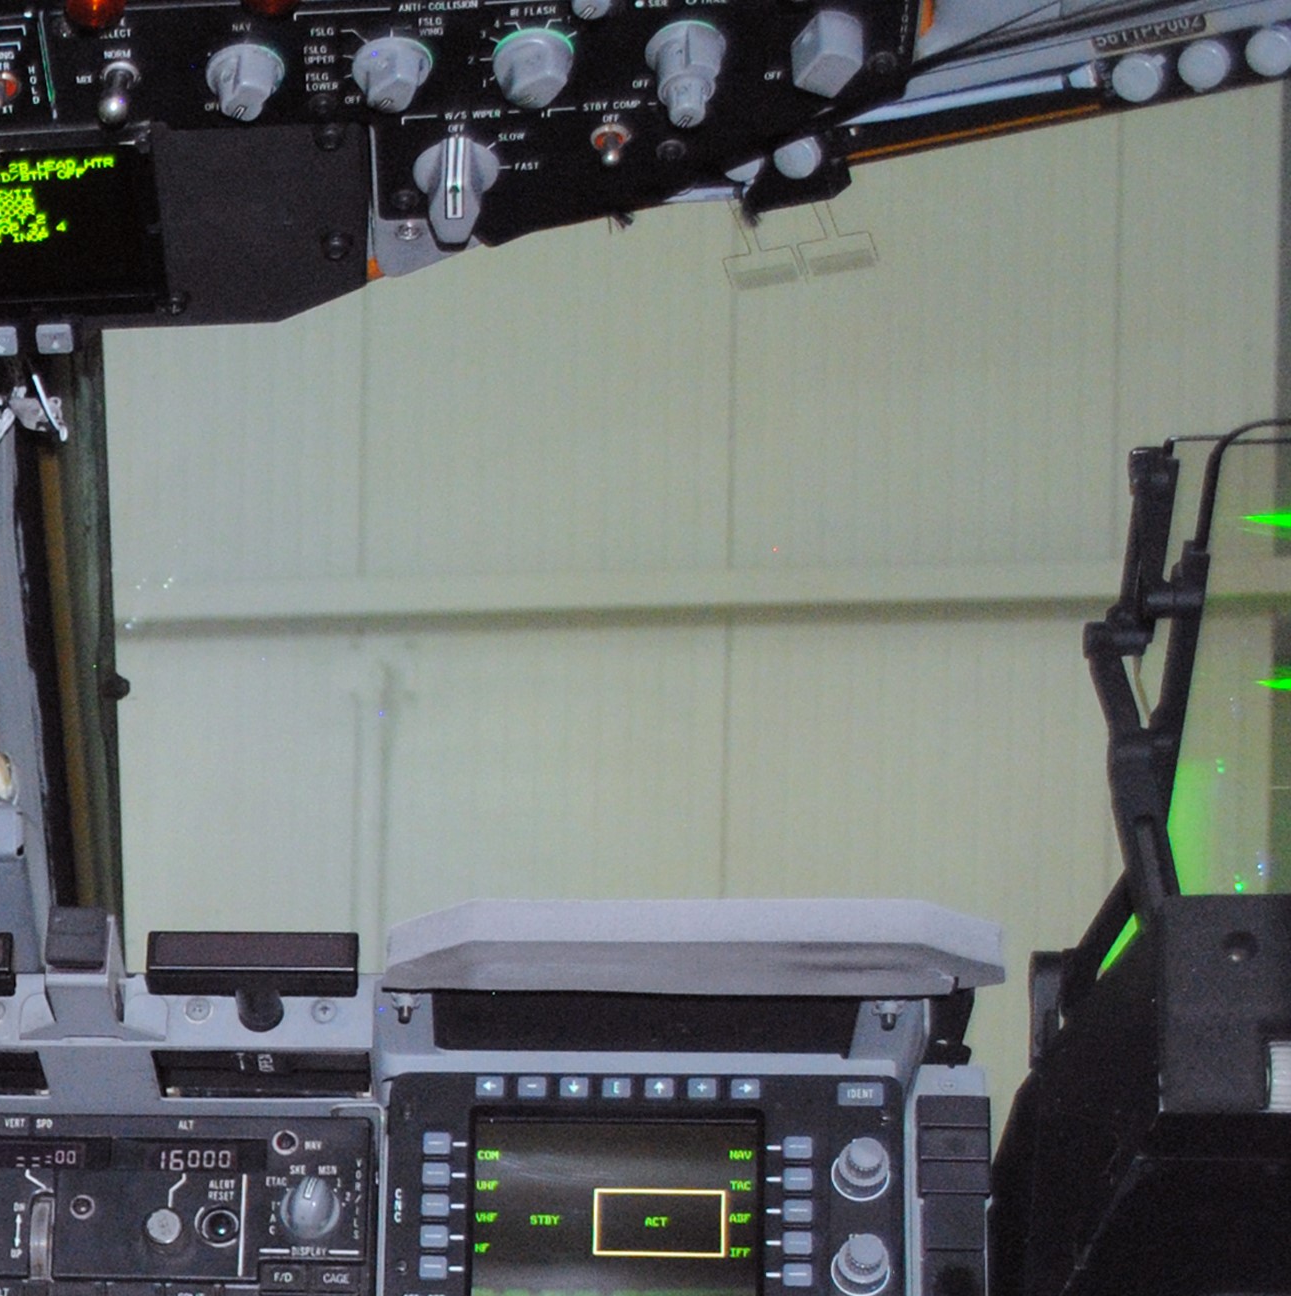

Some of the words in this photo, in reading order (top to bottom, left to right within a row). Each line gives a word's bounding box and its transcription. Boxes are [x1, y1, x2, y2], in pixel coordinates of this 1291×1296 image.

[522, 4, 556, 16] FLASH
[232, 23, 251, 32] NAV
[104, 50, 131, 59] NORM
[304, 46, 327, 55] FSLG
[764, 70, 782, 81] OFF
[305, 82, 339, 91] LOWER
[632, 79, 649, 90] OFF
[472, 109, 501, 119] WIPER
[602, 114, 620, 124] OFF
[448, 124, 465, 133] OFF
[498, 132, 525, 141] SLOW
[515, 161, 540, 171] FAST
[847, 1088, 874, 1099] IDENT
[4, 1118, 25, 1128] VERT
[36, 1119, 53, 1129] SPD
[178, 1120, 194, 1130] ALT
[160, 1150, 231, 1170] 16000
[477, 1150, 500, 1161] COM
[729, 1150, 753, 1161] NAV
[208, 1180, 236, 1189] ALERT
[266, 1177, 287, 1187] ETAC
[476, 1180, 499, 1191] UHF
[730, 1180, 752, 1191] TAC
[208, 1191, 234, 1201] RESET
[475, 1212, 498, 1223] VHF
[530, 1215, 561, 1226] STBY
[645, 1217, 669, 1228] ACT
[291, 1247, 328, 1257] DISPLAY
[474, 1243, 490, 1253] HF
[730, 1247, 751, 1258] IFF
[273, 1272, 293, 1282] F/D
[323, 1273, 349, 1284] CAGE
